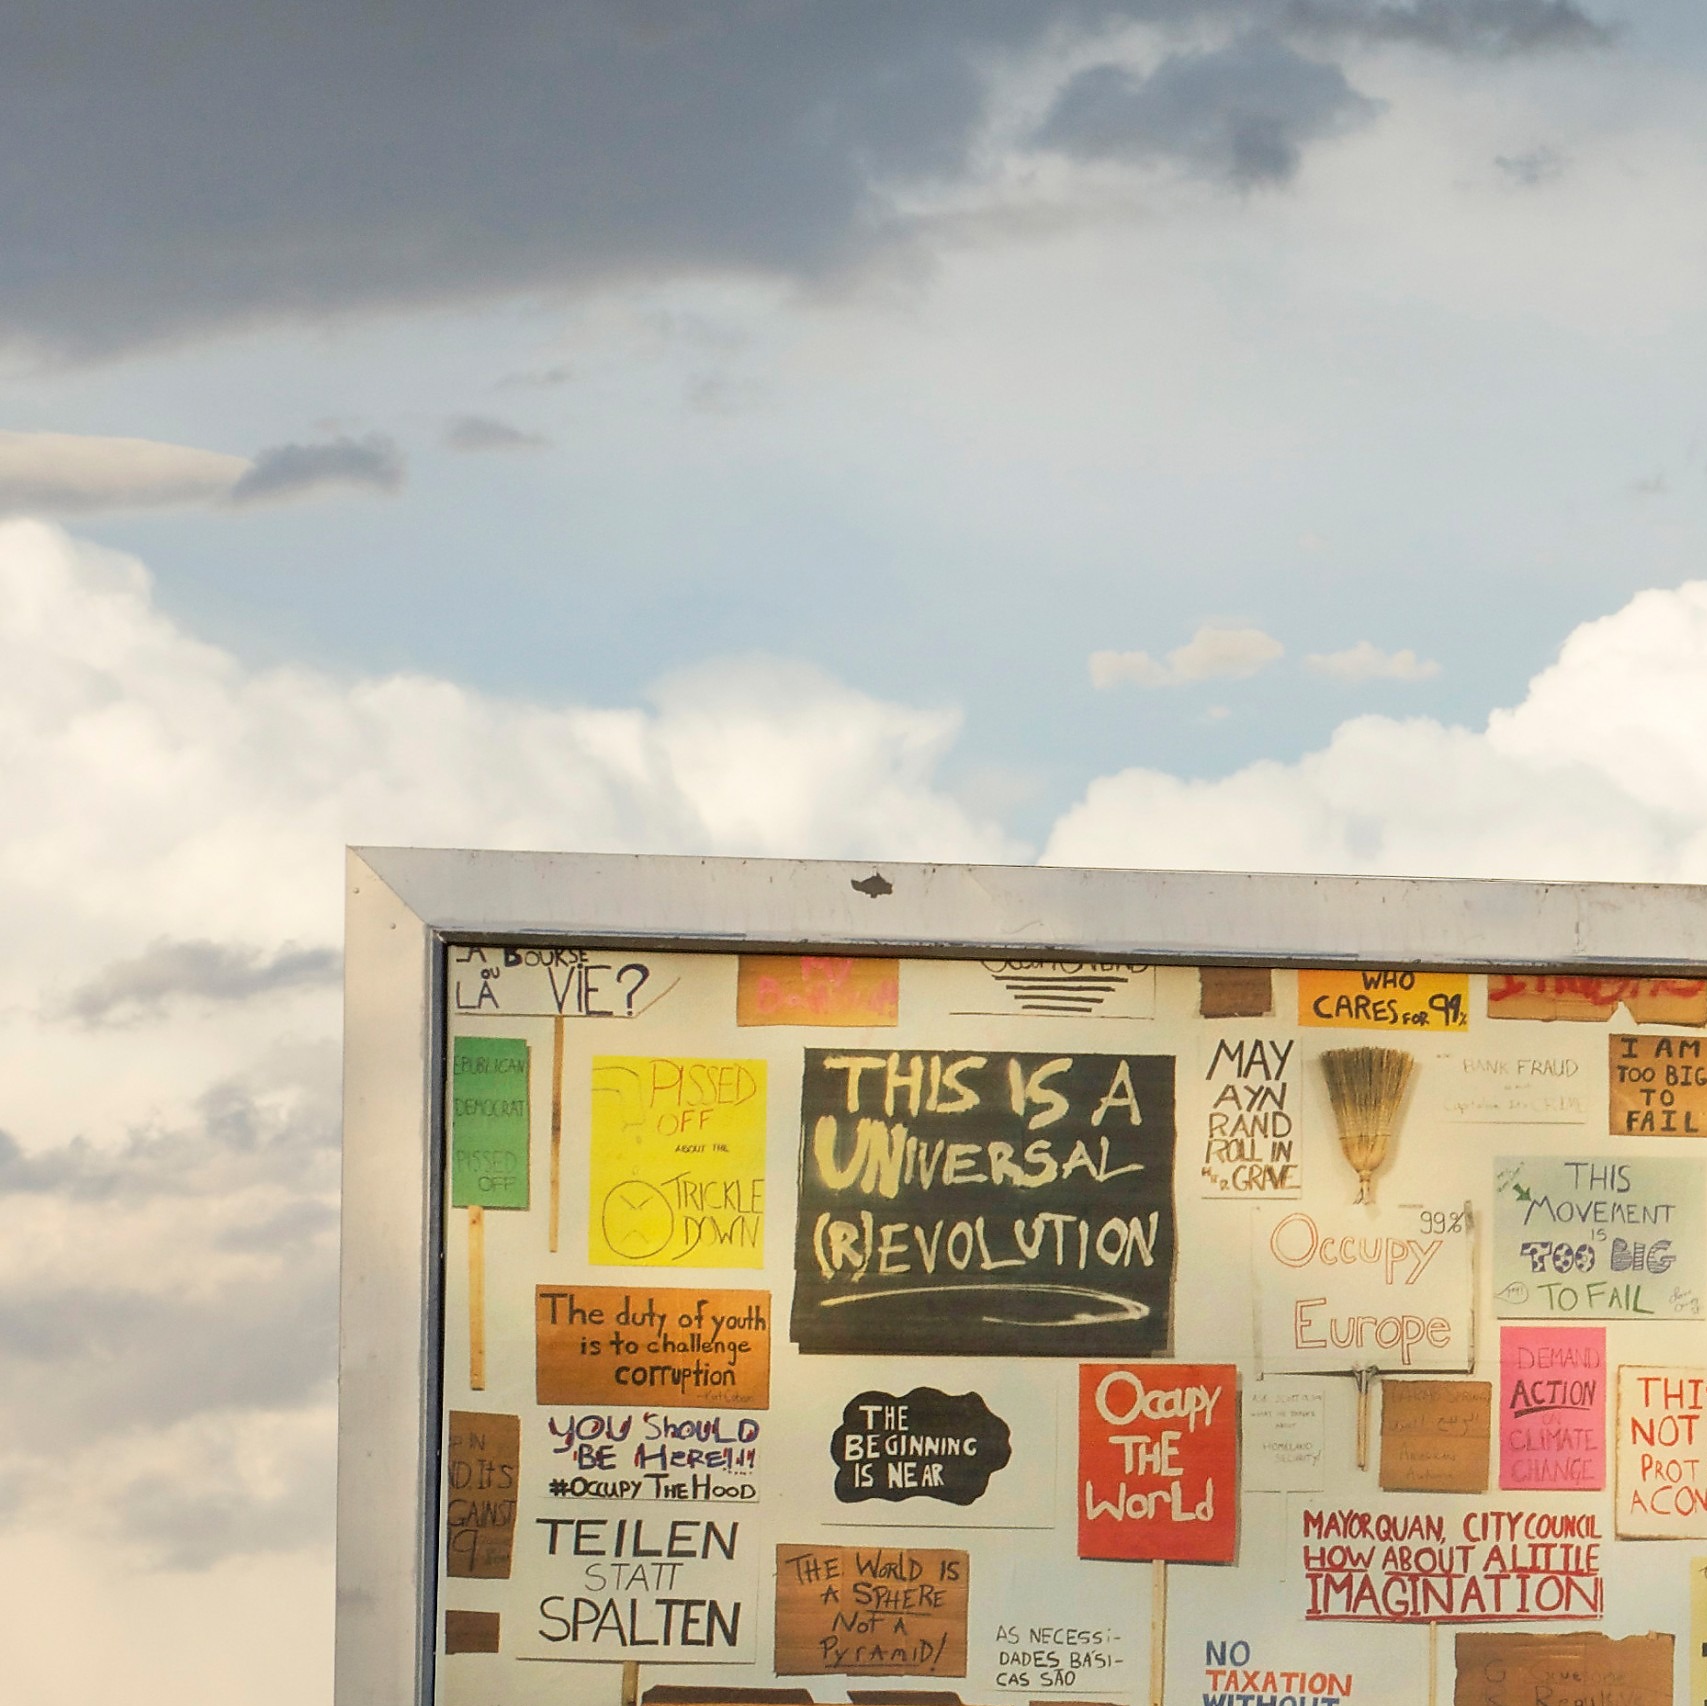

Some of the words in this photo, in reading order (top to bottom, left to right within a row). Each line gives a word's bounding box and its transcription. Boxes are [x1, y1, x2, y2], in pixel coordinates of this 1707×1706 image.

[1362, 970, 1415, 991] WHO
[1313, 994, 1398, 1025] CARES
[1402, 1012, 1429, 1026] FOR
[1206, 1038, 1294, 1081] MAY
[1620, 1037, 1638, 1058] I
[1655, 1038, 1700, 1059] AM
[1517, 1058, 1579, 1078] FRAUD
[1617, 1065, 1655, 1083] TOO
[650, 1060, 757, 1108] PISSED
[824, 1054, 988, 1118] THIS
[1009, 1056, 1073, 1130] IS
[1091, 1060, 1142, 1127] A
[1213, 1082, 1287, 1112] AYN
[1640, 1088, 1674, 1107] TO
[657, 1109, 714, 1136] OFF
[1209, 1111, 1292, 1138] RAND
[1626, 1110, 1699, 1133] FAIL
[813, 1115, 1144, 1199] UNIVERSAL
[1206, 1138, 1263, 1163] ROLL
[1271, 1140, 1293, 1163] IN
[1233, 1164, 1301, 1191] GRAVE
[1564, 1162, 1631, 1193] THIS
[660, 1171, 765, 1214] TRICKLE
[1420, 1210, 1465, 1234] 99%
[1524, 1195, 1676, 1225] MOVEMENT
[672, 1214, 760, 1260] DOWN
[813, 1210, 1159, 1284] (R)EVOLUTION
[1270, 1212, 1443, 1285] Occupy
[1591, 1228, 1607, 1241] IS
[1520, 1241, 1596, 1274] TOO
[1610, 1237, 1677, 1274] BIG
[1537, 1282, 1578, 1311] TO
[1586, 1282, 1654, 1315] FAIL
[540, 1293, 604, 1325] The
[616, 1296, 666, 1337] duty
[678, 1299, 709, 1330] of
[711, 1305, 767, 1343] youth
[1294, 1297, 1451, 1365] Europe
[581, 1336, 601, 1356] is
[610, 1331, 639, 1355] to
[646, 1333, 752, 1366] challenge
[1517, 1346, 1600, 1369] DEMAND
[614, 1360, 736, 1394] corruption
[1509, 1379, 1596, 1410] ACTION
[859, 1405, 909, 1431] THE
[1631, 1414, 1699, 1446] NOT
[844, 1434, 978, 1462] BEGINNING
[1108, 1430, 1184, 1476] THE
[1509, 1427, 1598, 1451] CLIMATE
[574, 1444, 616, 1470] BE
[854, 1462, 874, 1488] IS
[888, 1461, 945, 1489] NEAR
[1511, 1458, 1596, 1486] CHANGE
[1630, 1489, 1648, 1515] A
[536, 1518, 739, 1560] TEILEN
[1304, 1509, 1373, 1540] MAYOR
[1463, 1511, 1523, 1542] CITY
[1524, 1512, 1602, 1540] COUNCIL
[939, 1560, 960, 1581] IS
[1304, 1545, 1375, 1570] HOW
[1382, 1545, 1475, 1574] ABOUT
[1483, 1544, 1506, 1572] A
[1511, 1543, 1600, 1574] LITTLE
[585, 1563, 684, 1592] STATT
[820, 1584, 840, 1605] A
[853, 1581, 947, 1610] SPHERE
[539, 1596, 741, 1647] SPALTEN
[893, 1616, 908, 1636] A
[996, 1625, 1019, 1644] AS
[1000, 1651, 1060, 1668] DADES
[1206, 1640, 1250, 1667] NO
[996, 1672, 1030, 1687] CAS
[1205, 1669, 1352, 1697] TAXATION
